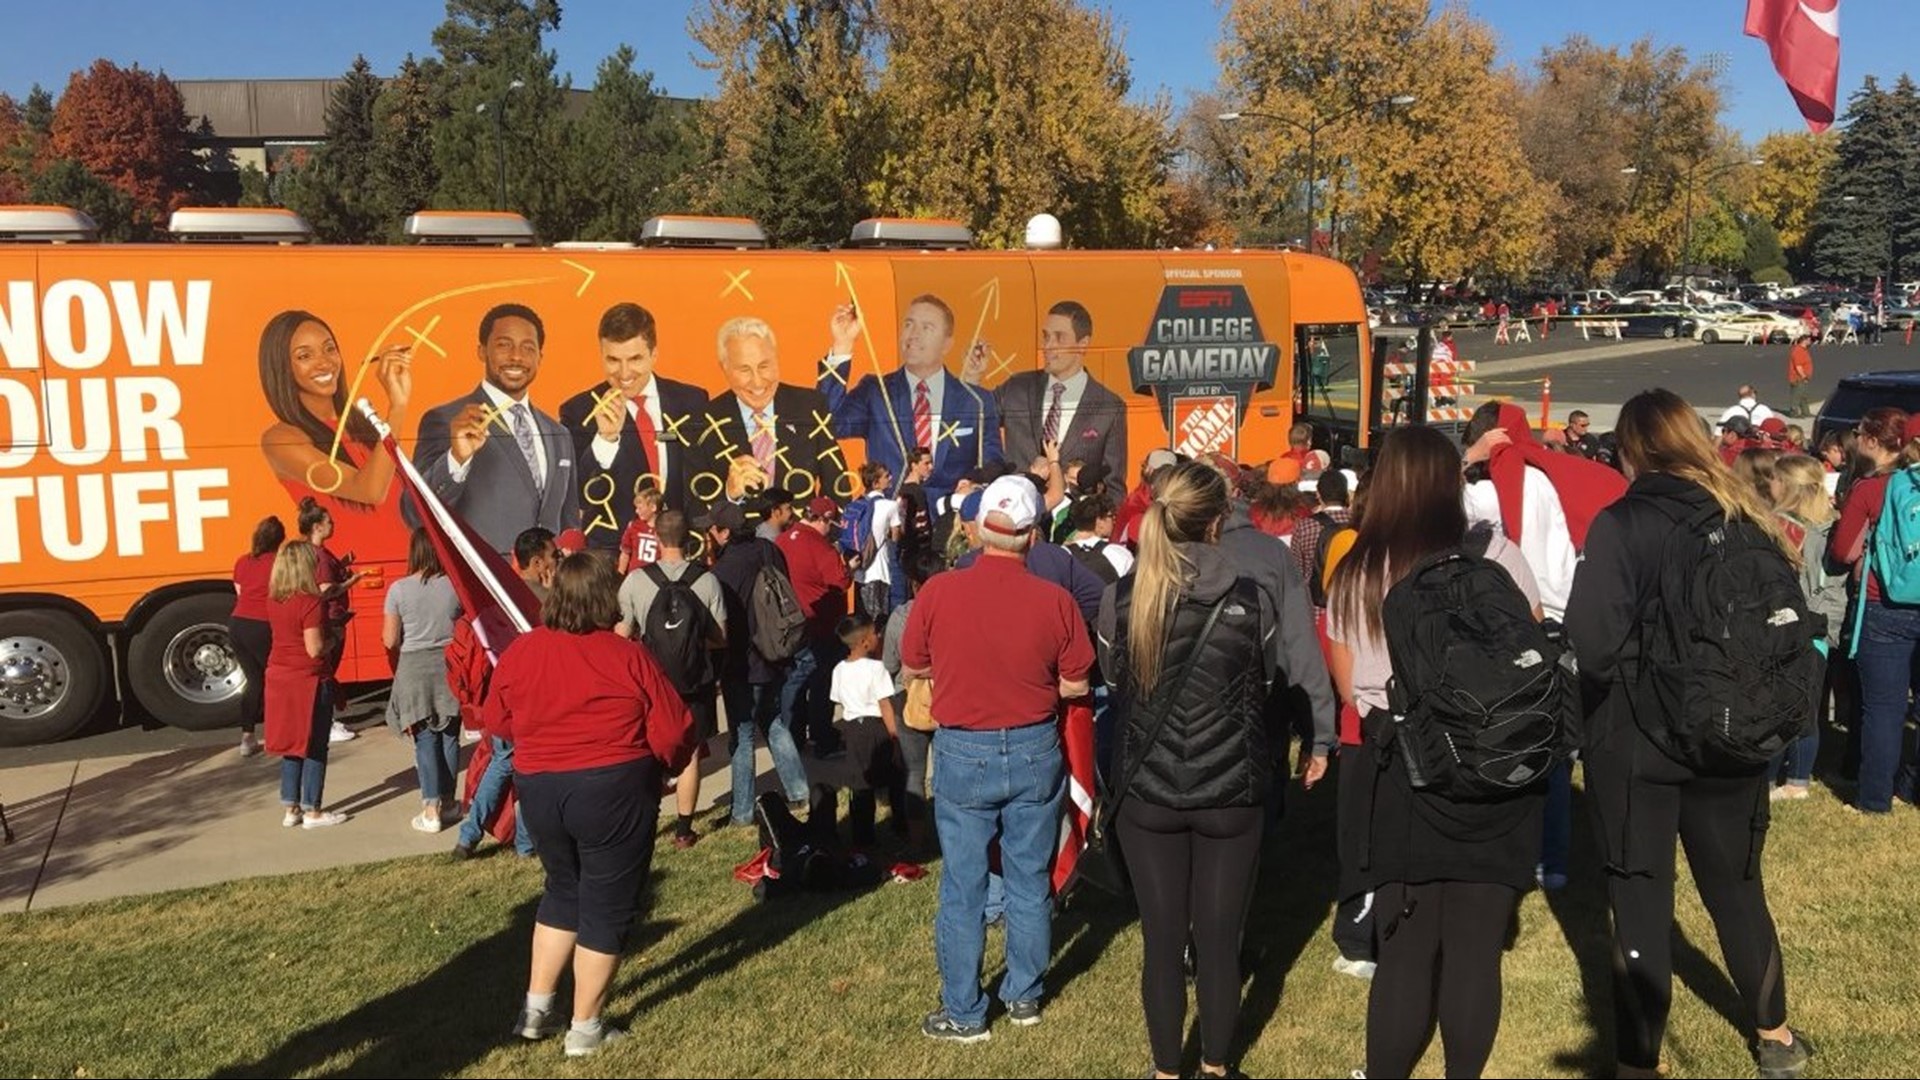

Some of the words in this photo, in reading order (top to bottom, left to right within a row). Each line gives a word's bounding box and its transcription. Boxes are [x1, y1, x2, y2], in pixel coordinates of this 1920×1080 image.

[1164, 268, 1201, 279] OFFICIAL
[1203, 268, 1242, 279] SPONSOR
[1179, 290, 1233, 309] ESPN
[1157, 317, 1253, 343] COLLEGE
[1142, 347, 1270, 381] GAMEDAY
[1188, 386, 1209, 396] BUILT
[1210, 386, 1221, 395] BY
[1180, 404, 1207, 433] THE
[638, 538, 657, 562] 15
